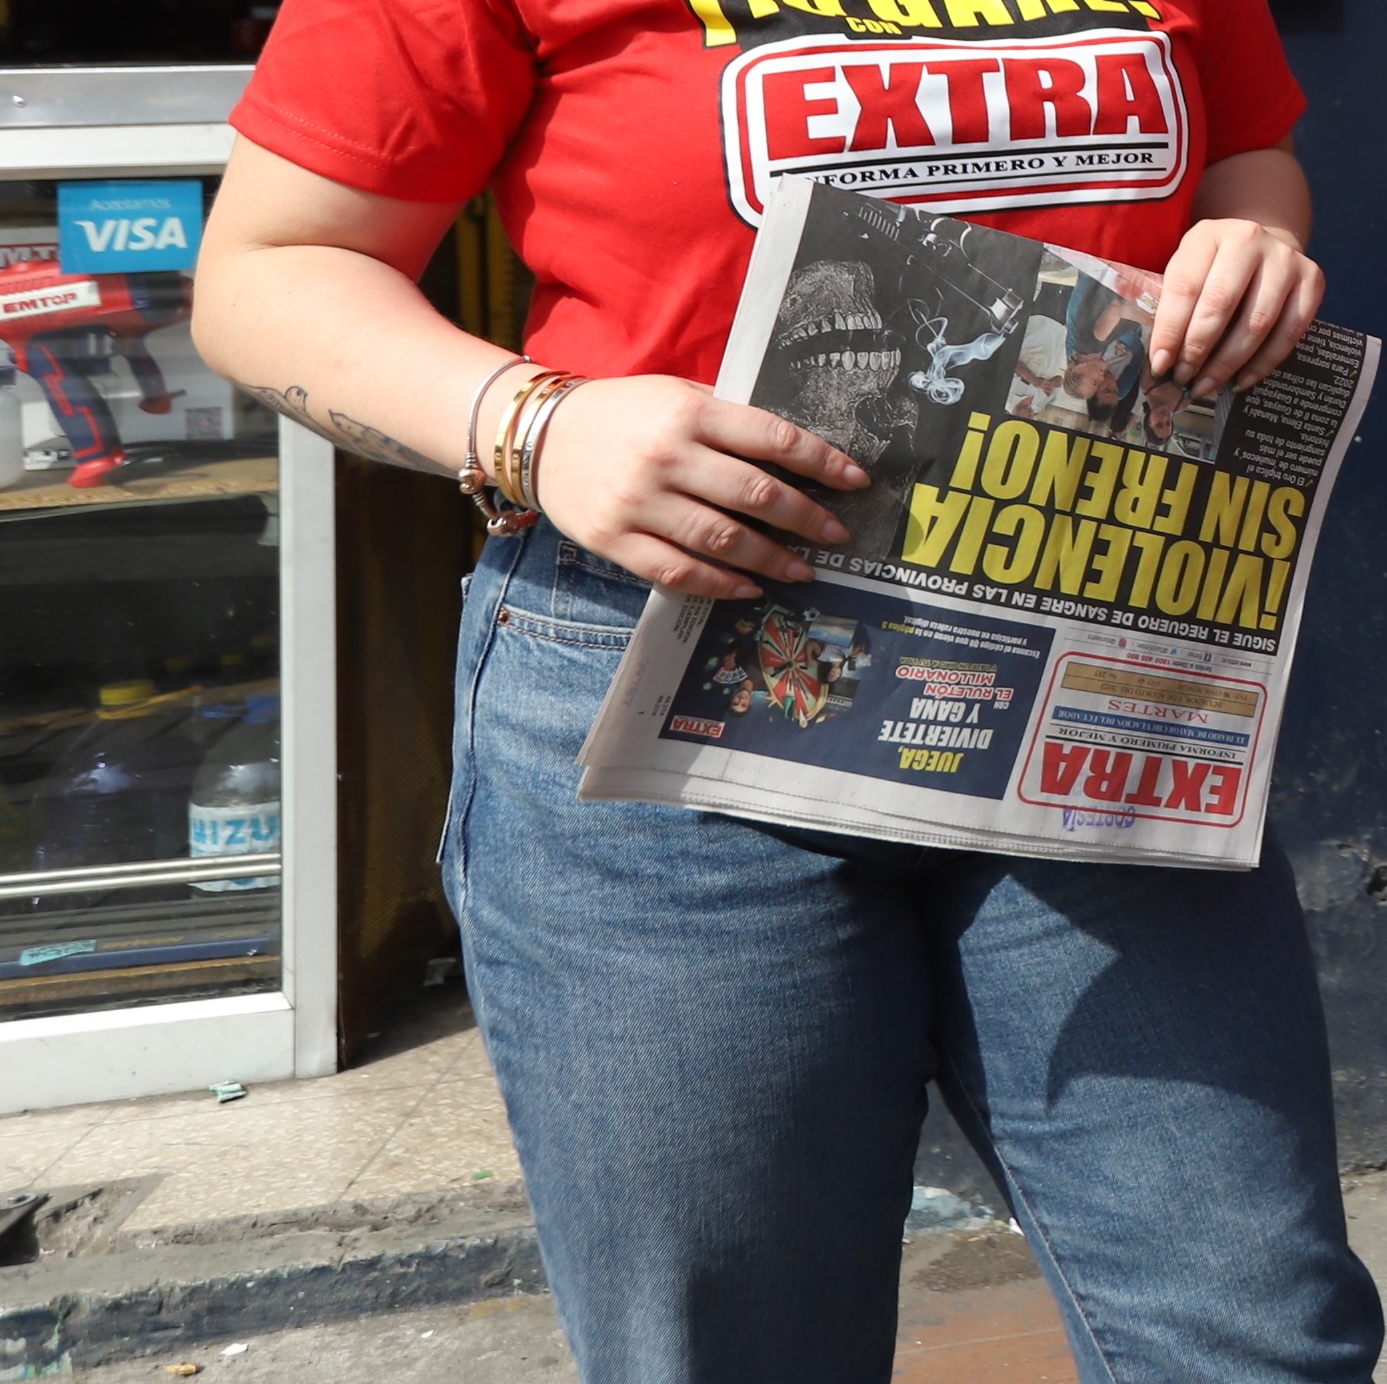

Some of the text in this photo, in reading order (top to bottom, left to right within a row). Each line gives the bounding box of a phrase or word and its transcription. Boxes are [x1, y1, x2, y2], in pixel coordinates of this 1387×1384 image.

[846, 16, 901, 35] CON
[762, 54, 1168, 161] EXTRA
[804, 152, 1155, 186] FORMA PRIMERO Y MEJOR
[74, 217, 188, 252] VISA
[2, 293, 77, 314] EMTOP
[1316, 325, 1333, 337] por
[1304, 333, 1363, 358] violencia, tiene
[1292, 351, 1350, 375] Para sorpresa,
[1311, 346, 1362, 368] Esmeraldas,
[1276, 370, 1351, 398] duplican las cifras
[1330, 374, 1355, 388] 2022.
[1243, 393, 1262, 404] que
[1259, 377, 1347, 408] Durán y Samborondón
[1292, 397, 1299, 405] a
[1258, 397, 1294, 415] Guayas,
[1291, 408, 1304, 418] de
[1297, 398, 1344, 417] comprende
[1241, 404, 1327, 435] Santa Elena, Manabí y
[1308, 412, 1331, 425] zona
[1329, 418, 1338, 428] la
[1243, 429, 1327, 455] sangriento de toda su
[1296, 431, 1331, 447] historia.
[1232, 447, 1240, 457] y
[1257, 444, 1323, 466] puede ser el más
[1245, 463, 1305, 485] El Oro triplica el
[1277, 460, 1289, 470] de
[1287, 462, 1320, 477] número
[949, 411, 1307, 560] SIN FRENO!
[815, 549, 845, 568] DE
[901, 482, 1291, 631] ¡VIOLENCIA
[842, 556, 971, 595] PROVINCIAS
[969, 582, 1009, 601] LAS
[1009, 589, 1038, 607] EN
[1037, 595, 1110, 621] SANGRE
[1108, 608, 1135, 625] DE
[913, 627, 923, 636] la
[922, 629, 933, 637] en
[928, 621, 952, 632] ruleta
[952, 626, 980, 637] nuestra
[1135, 614, 1210, 640] REGUERO
[1208, 627, 1231, 643] EL
[932, 631, 954, 642] viene
[954, 634, 970, 644] que
[968, 638, 979, 647] QR
[979, 639, 1004, 651] código
[989, 631, 1023, 645] participa
[1229, 631, 1277, 651] SIGUE
[1003, 644, 1012, 653] el
[1010, 646, 1040, 658] Escanea
[896, 666, 995, 684] MILLONARIO
[925, 685, 1012, 702] EL RULETÓN
[910, 696, 982, 724] Y GANA
[994, 701, 1009, 710] CON
[1105, 699, 1210, 723] MARTES
[1056, 709, 1098, 723] ECUADOR
[1097, 715, 1114, 724] DEL
[672, 718, 723, 737] EXTRA
[880, 720, 994, 750] DIVIERTETE
[1168, 725, 1194, 736] MAYOR
[1056, 726, 1236, 759] INFORMA PRIMERO Y MEJOR
[898, 746, 964, 772] JUEGA,
[1040, 741, 1243, 816] EXTRA
